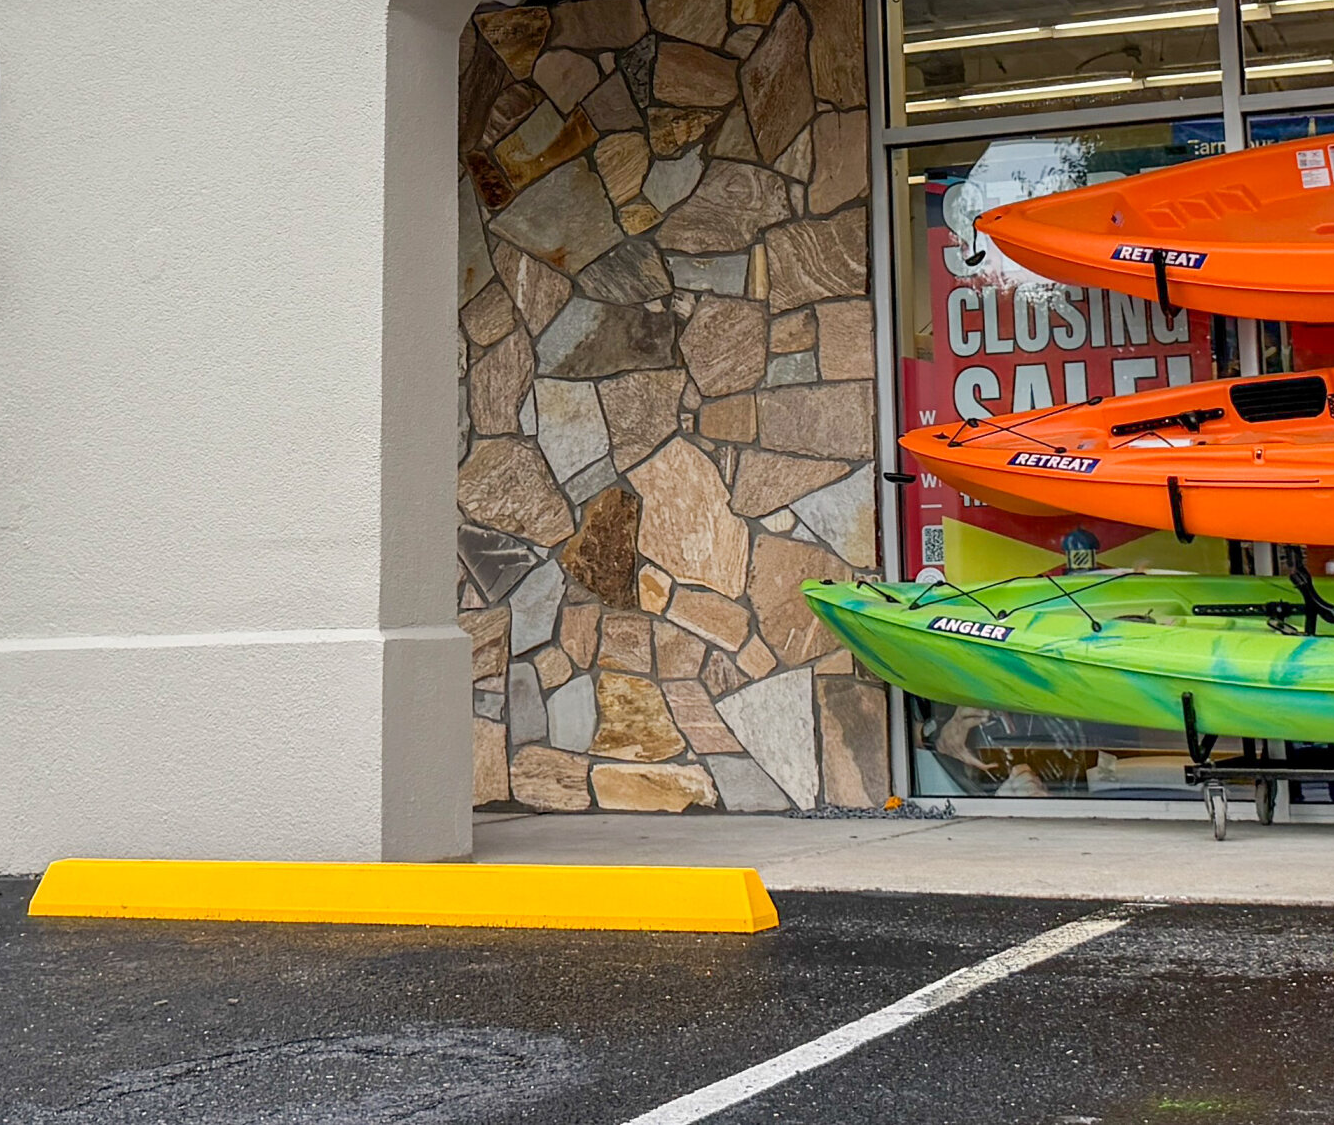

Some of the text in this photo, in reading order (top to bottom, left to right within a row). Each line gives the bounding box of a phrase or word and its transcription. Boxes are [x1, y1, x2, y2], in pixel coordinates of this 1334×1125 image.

[1119, 246, 1200, 267] RETEAT
[1015, 453, 1092, 473] RETREAT
[933, 617, 1007, 641] ANGLER
